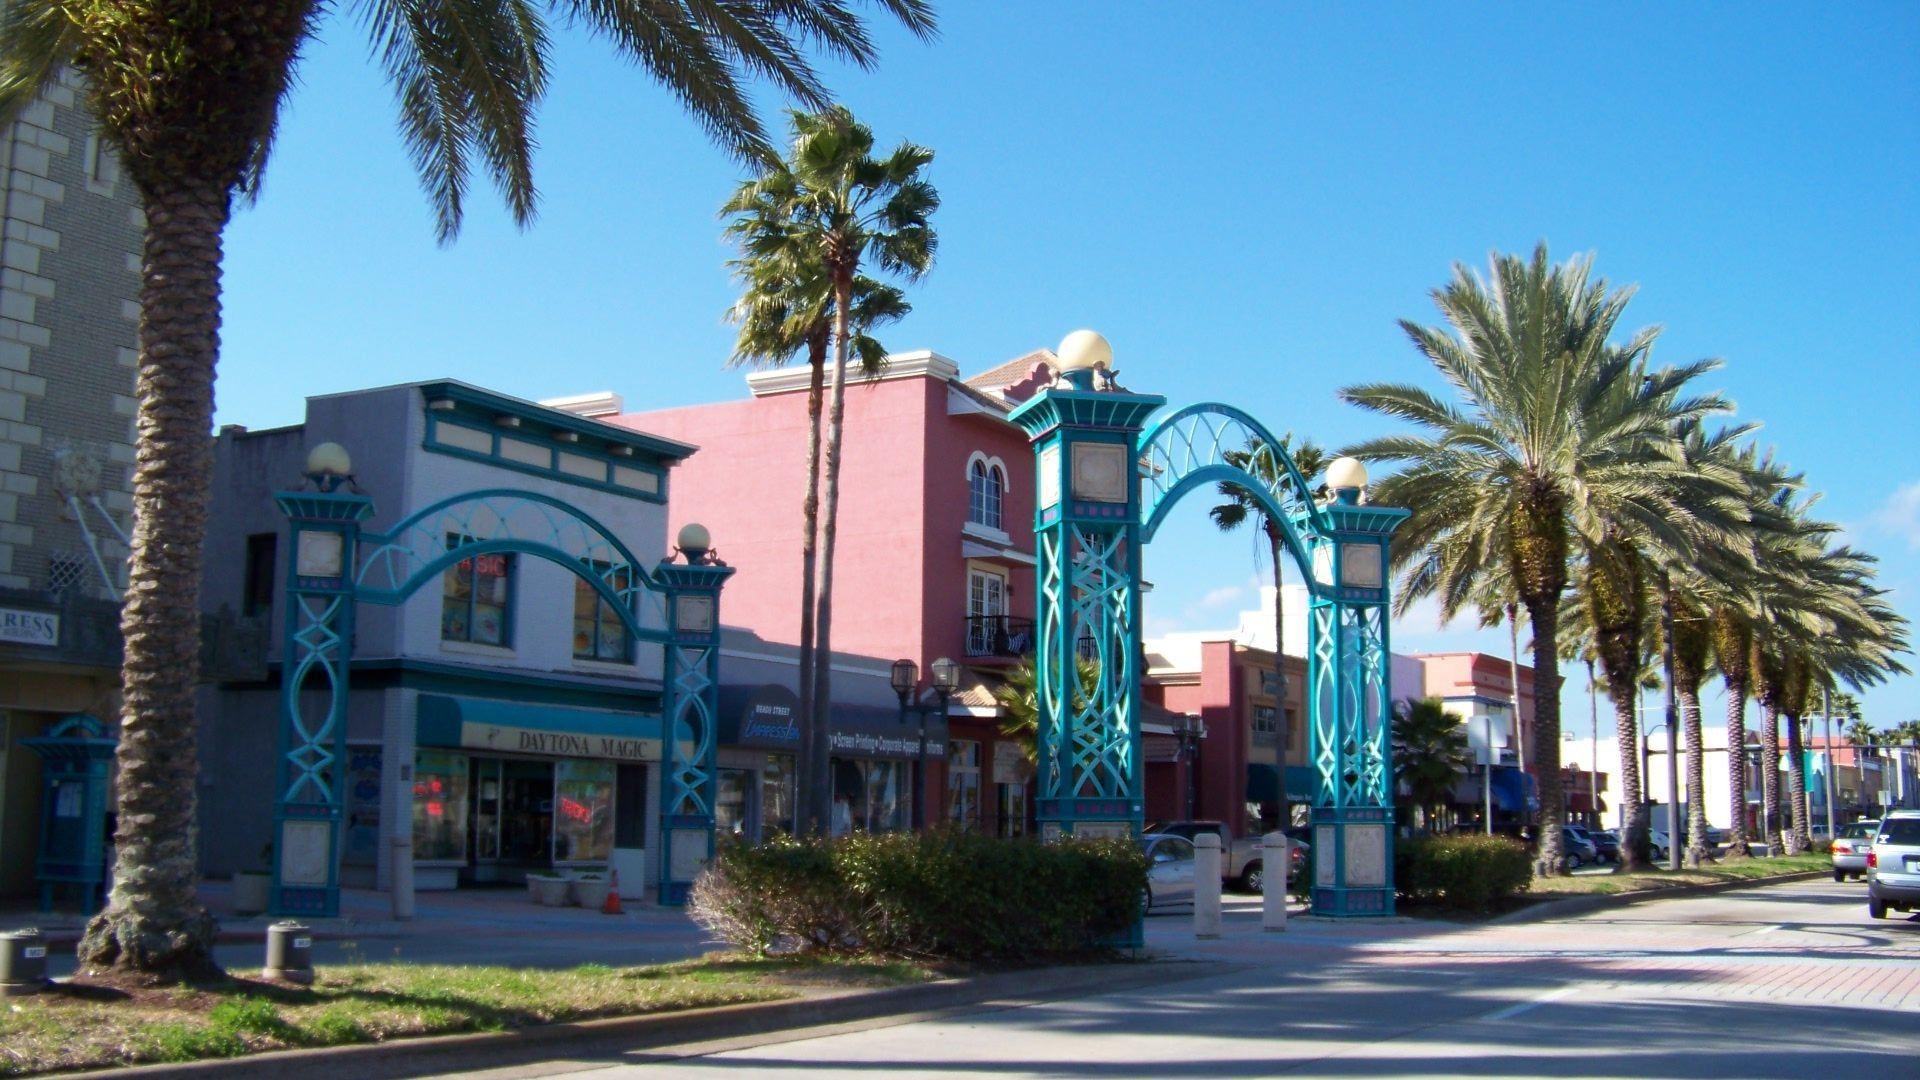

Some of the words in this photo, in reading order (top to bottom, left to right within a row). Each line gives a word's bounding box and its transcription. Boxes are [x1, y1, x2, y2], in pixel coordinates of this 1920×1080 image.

[0, 612, 54, 640] RESS
[519, 731, 590, 754] DAYTONA
[601, 738, 648, 758] MAGIC
